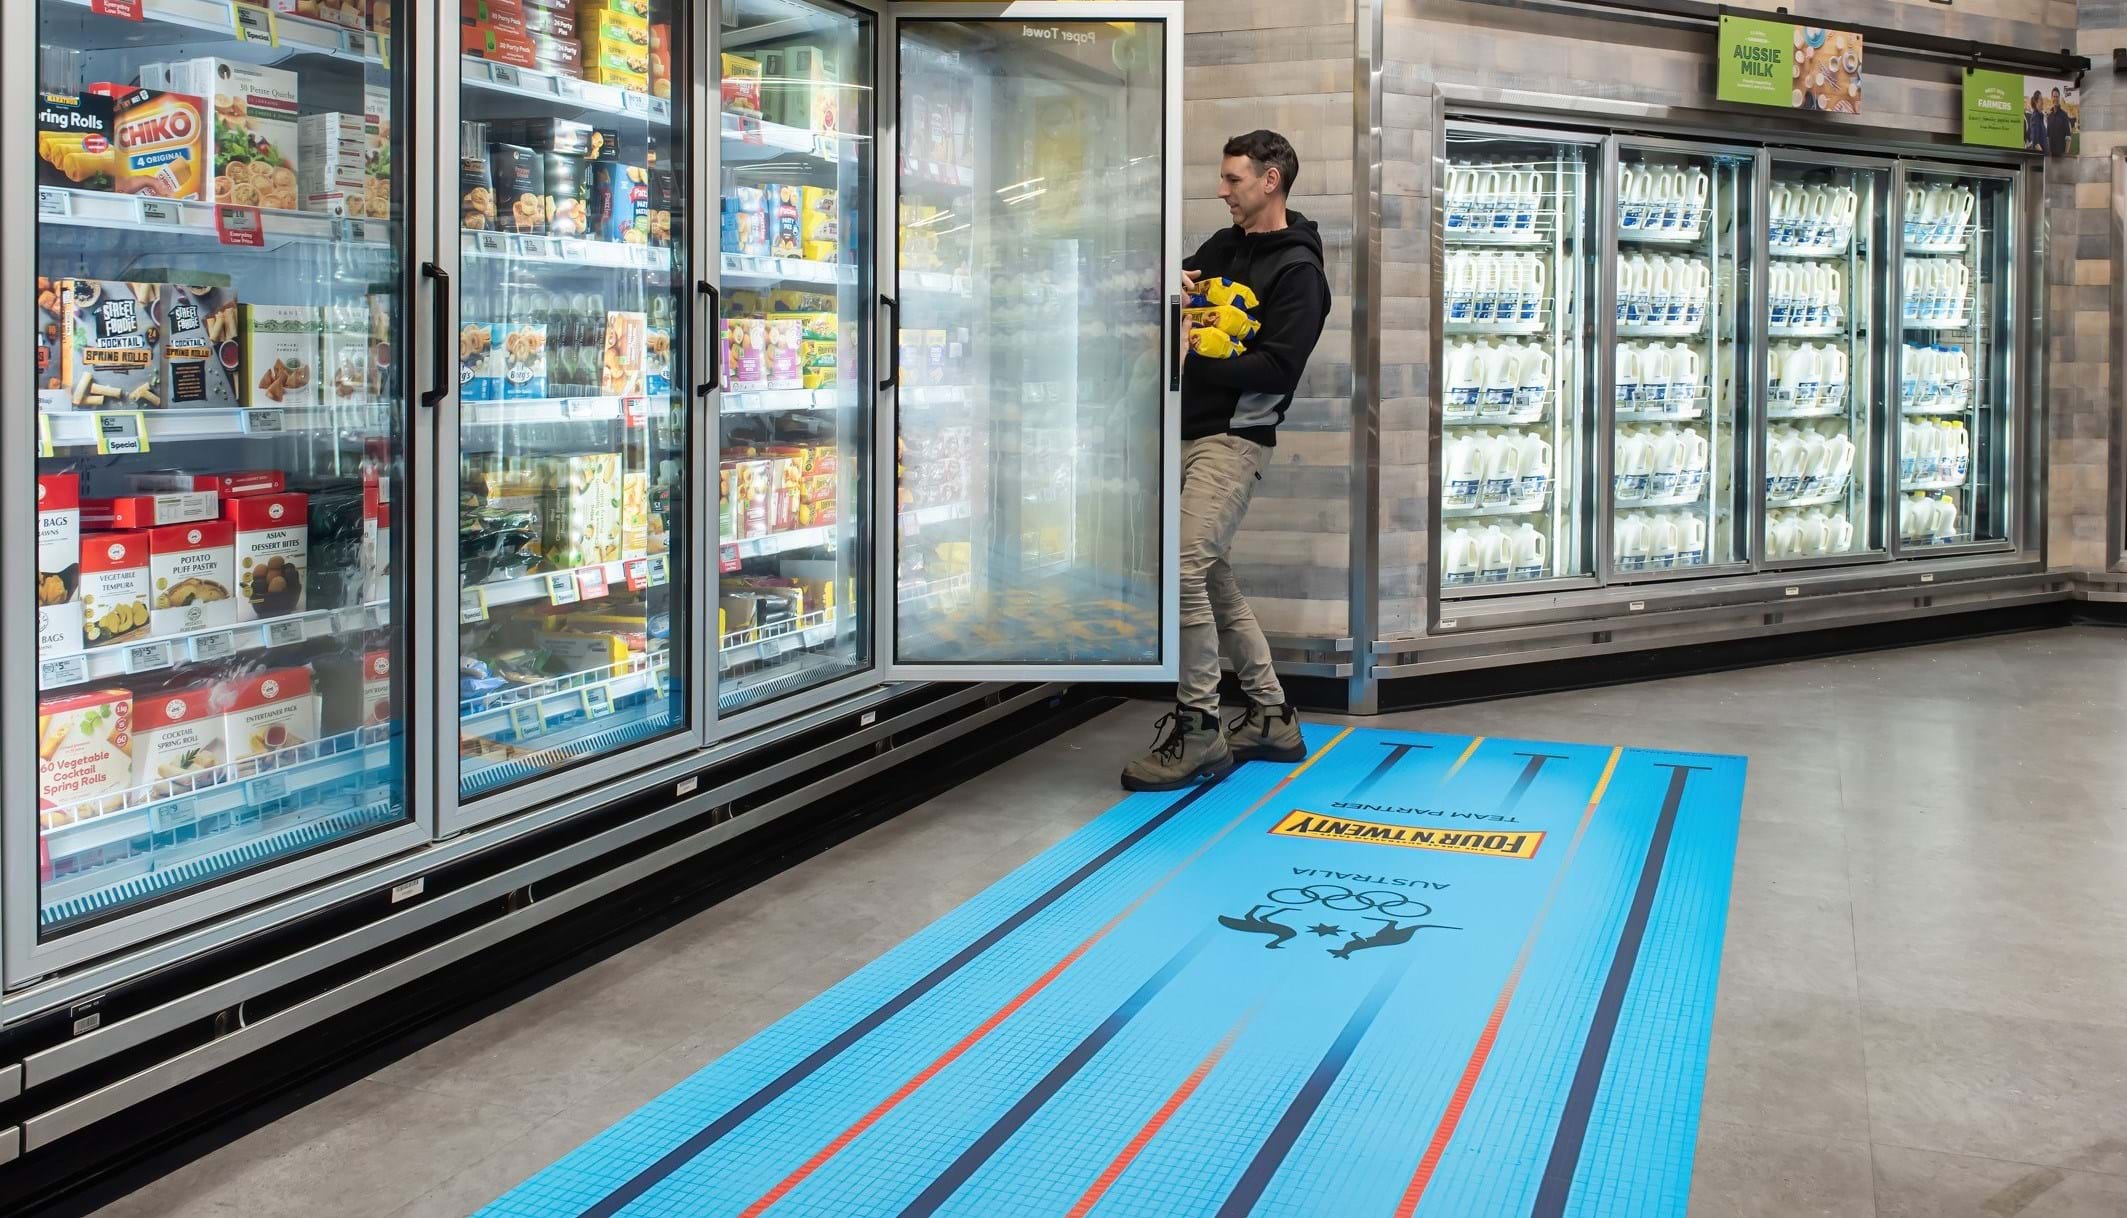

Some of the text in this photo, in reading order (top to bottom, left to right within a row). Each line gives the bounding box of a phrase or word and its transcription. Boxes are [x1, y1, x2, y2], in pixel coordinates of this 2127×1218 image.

[1733, 44, 1782, 64] AUSSIE
[1741, 60, 1774, 78] MILK
[1977, 98, 2012, 111] FARMERS
[70, 112, 103, 130] Rolls
[118, 111, 192, 149] CHIKO
[136, 157, 145, 167] 4
[102, 300, 136, 321] STREET
[175, 304, 198, 321] STREET
[105, 317, 138, 338] FOODIE
[177, 316, 200, 332] FOODIE
[100, 337, 140, 349] COCKTAIL
[174, 338, 204, 348] COCKTAIL
[85, 350, 149, 363] SPRING ROLLS
[166, 348, 210, 358] SPRING ROLLS
[110, 440, 138, 451] Special
[43, 516, 68, 528] BAGS
[266, 531, 287, 540] ASIAN
[251, 539, 300, 552] DESSERT BITES
[180, 553, 211, 565] POTATO
[172, 562, 218, 575] PUFF PASTRY
[99, 571, 136, 583] VEGETABLE
[102, 581, 134, 592] TEMPURA
[41, 633, 64, 644] BAGS
[246, 705, 298, 724] ENTERTAINER PACK
[116, 735, 127, 744] 60
[161, 728, 193, 740] COCKTAIL
[157, 735, 199, 750] SPRING ROLL
[40, 751, 110, 774] 60 Vegetable
[53, 765, 96, 782] Cocktail
[43, 773, 107, 796] Spring Rolls
[1331, 801, 1520, 823] TEAM PARTNER
[1286, 816, 1407, 841] TWENTY
[1438, 833, 1526, 853] FOUR
[1292, 867, 1451, 890] AUSTRALIA
